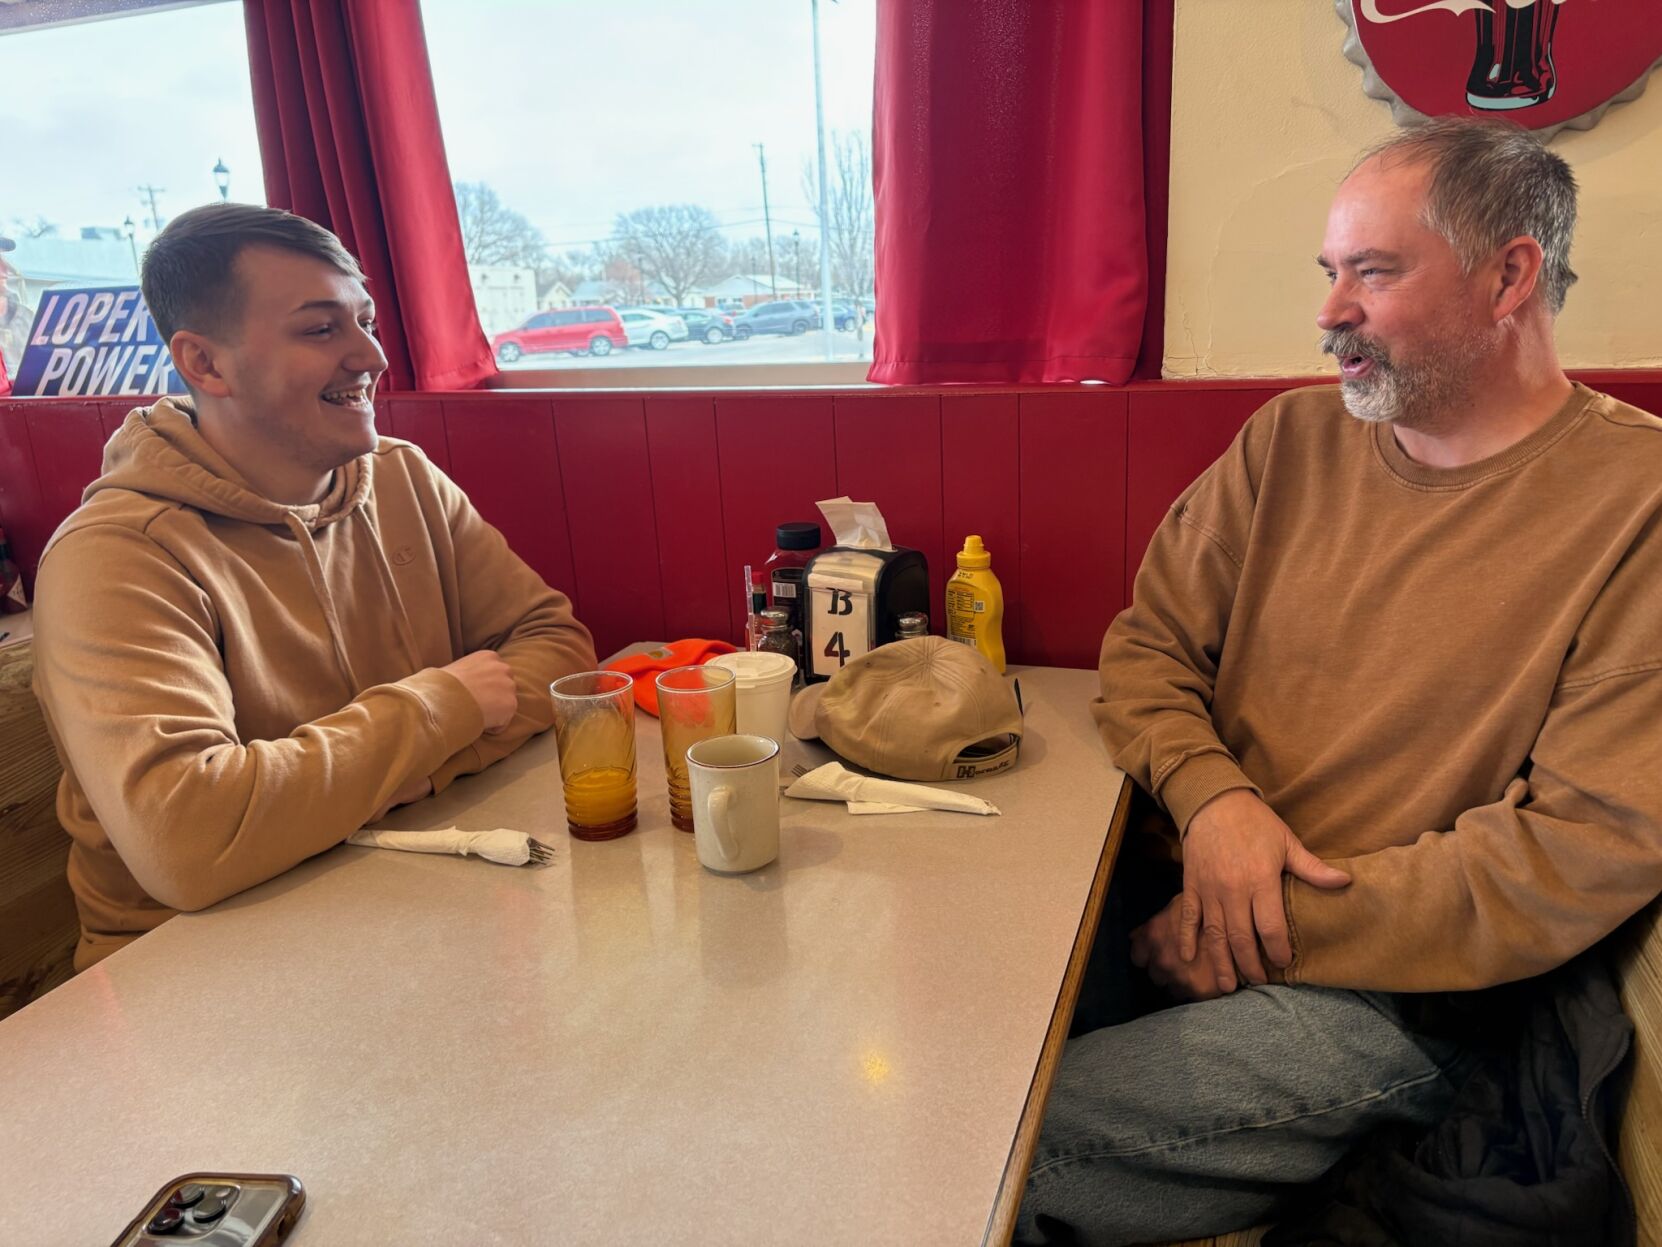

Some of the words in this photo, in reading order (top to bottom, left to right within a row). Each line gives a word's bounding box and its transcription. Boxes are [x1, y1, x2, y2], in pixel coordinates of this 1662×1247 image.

[31, 291, 150, 345] LOPER
[34, 345, 174, 396] POWER
[826, 587, 853, 615] B
[824, 631, 850, 667] 4
